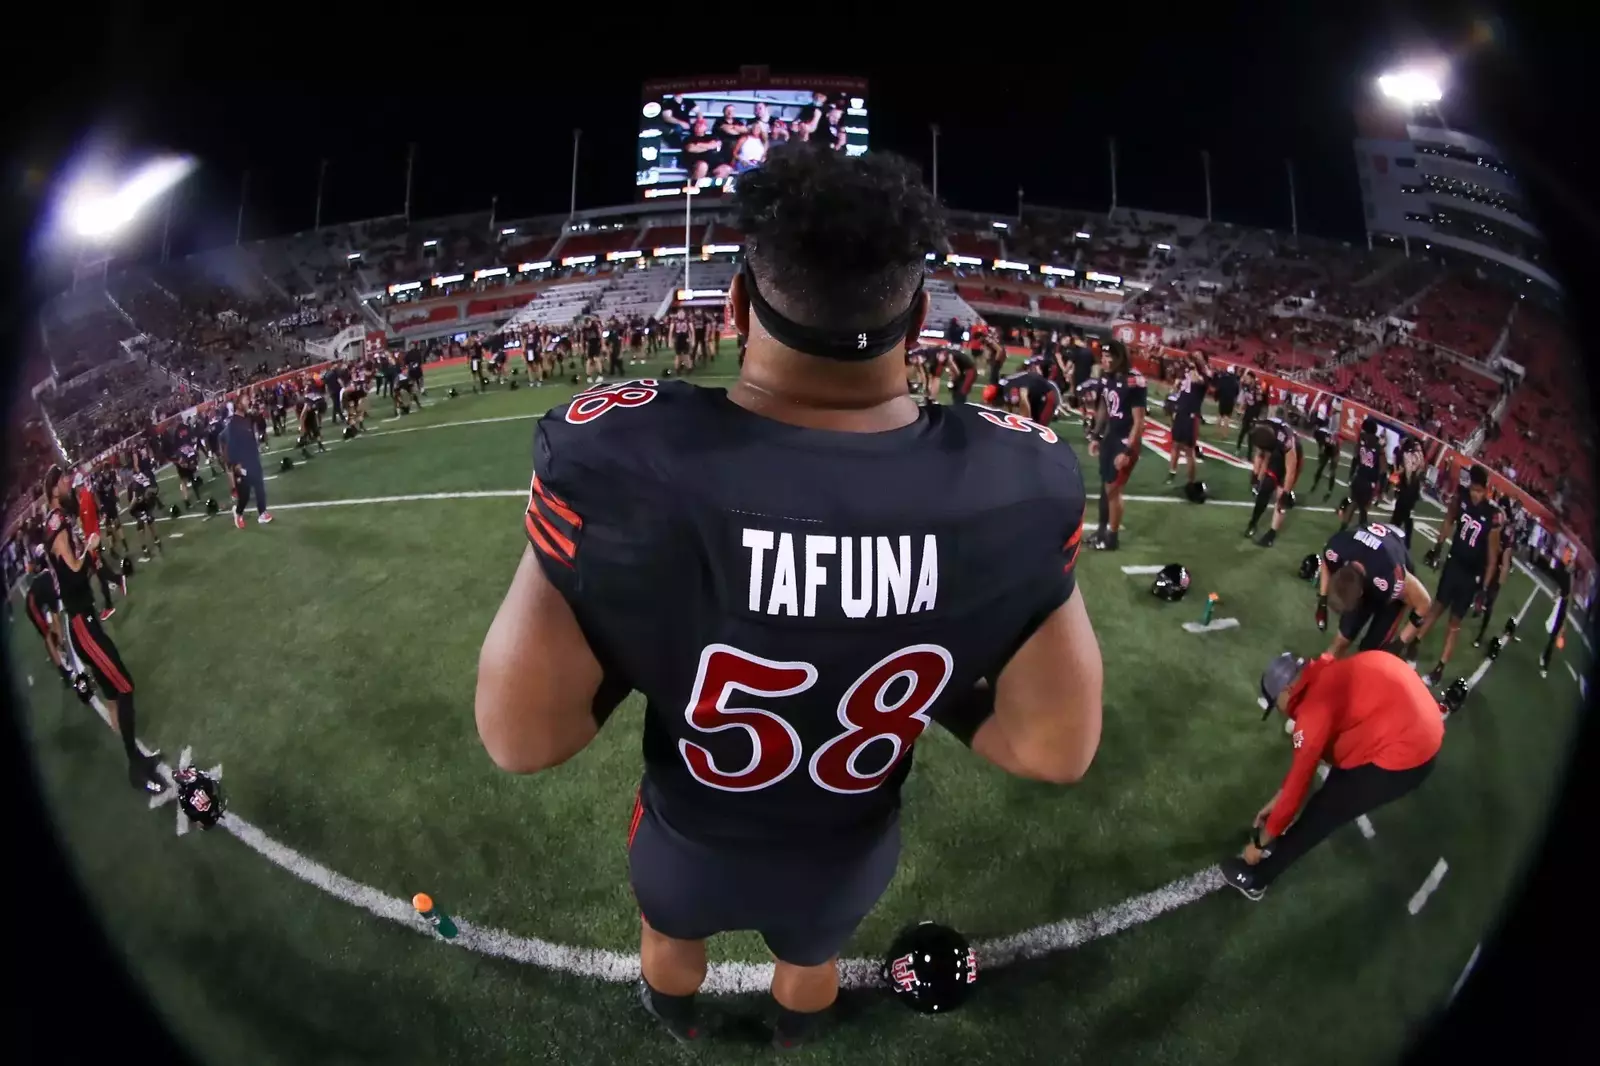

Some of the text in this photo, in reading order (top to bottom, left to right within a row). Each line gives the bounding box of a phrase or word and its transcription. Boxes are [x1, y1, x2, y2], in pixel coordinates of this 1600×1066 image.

[742, 528, 938, 618] TAFUNA
[1460, 513, 1482, 547] 77
[679, 643, 954, 794] 58
